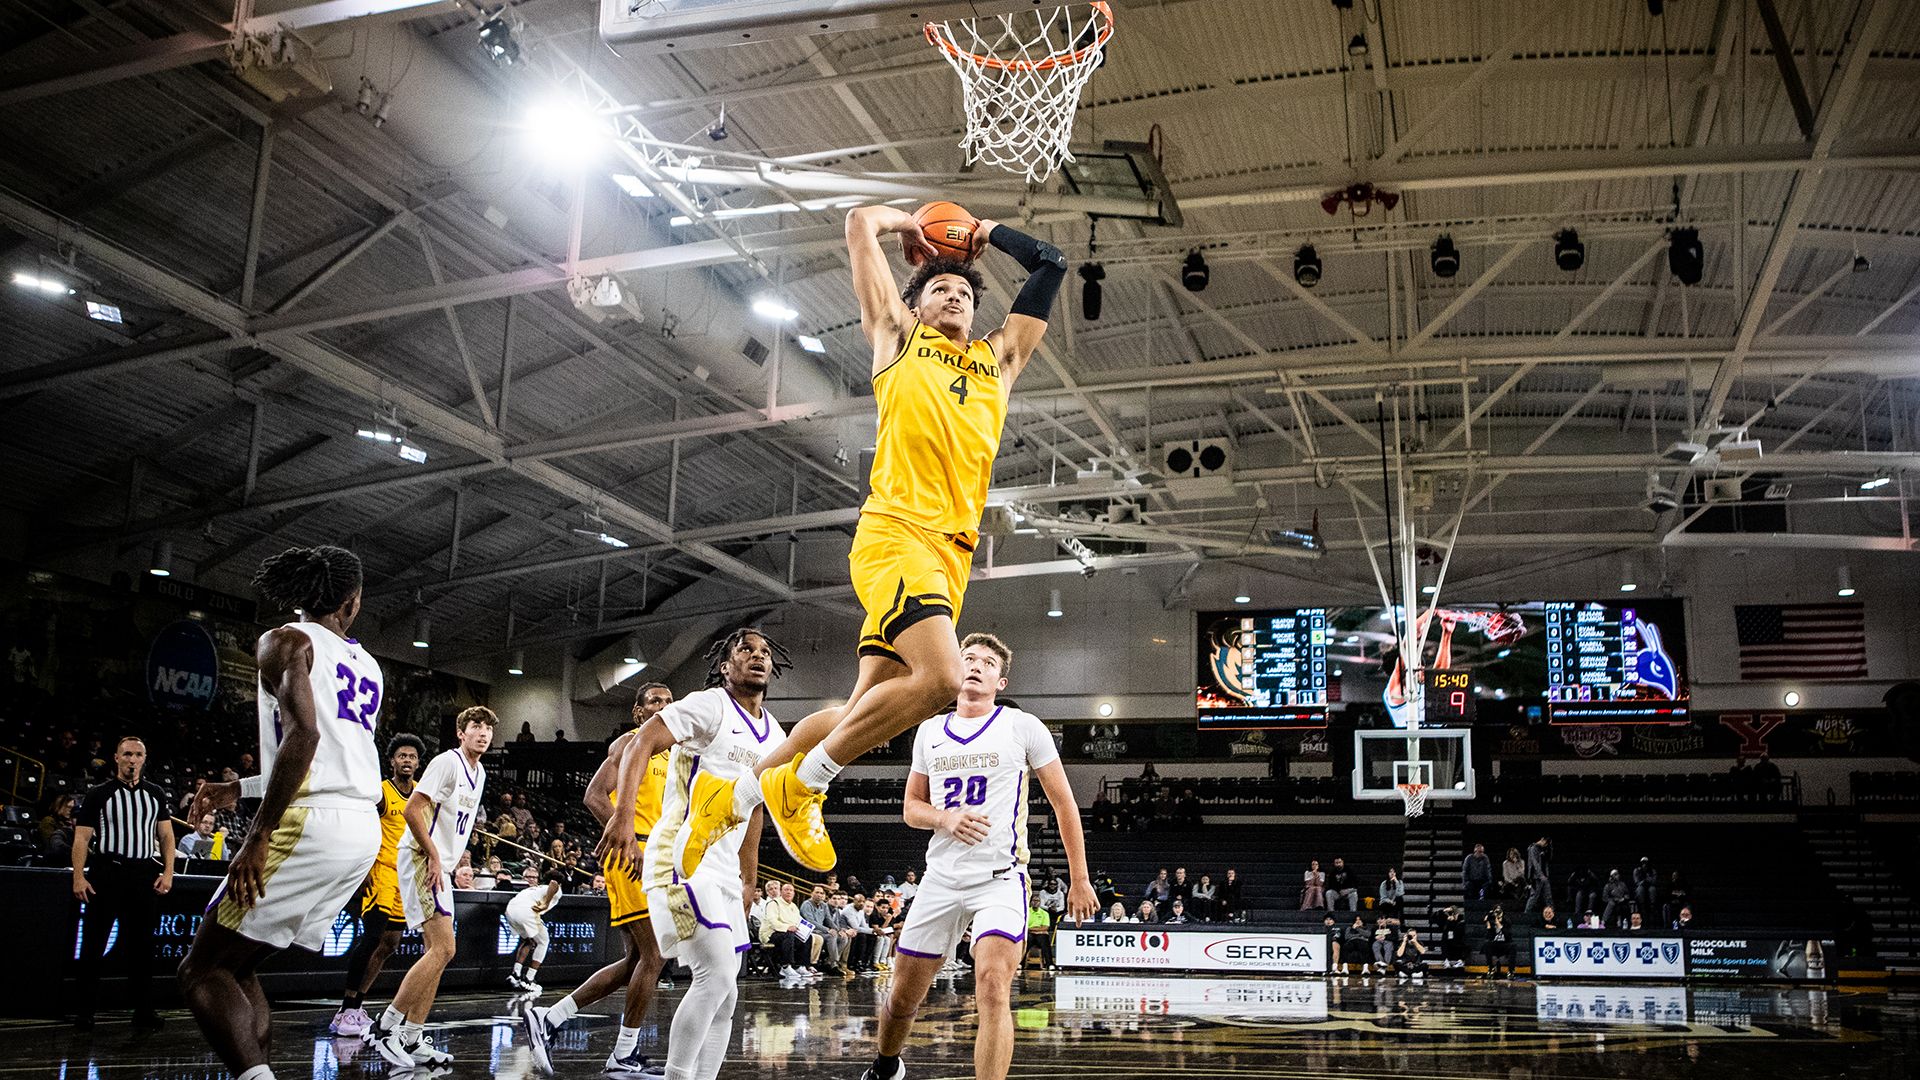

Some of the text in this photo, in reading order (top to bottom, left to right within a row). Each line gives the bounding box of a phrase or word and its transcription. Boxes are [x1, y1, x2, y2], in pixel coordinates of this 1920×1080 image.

[917, 347, 999, 379] OAKLAND
[949, 374, 968, 405] 4
[158, 581, 242, 613] GOLD ZONE
[1550, 611, 1633, 622] 0 1 3
[1314, 619, 1322, 627] 2
[1551, 626, 1636, 637] 0 0 20
[1315, 648, 1322, 656] 4
[1551, 641, 1637, 652] 0 0 22
[1315, 663, 1322, 671] 0
[1552, 658, 1559, 667] 0
[1567, 658, 1573, 667] 0
[154, 666, 213, 699] NCAA
[1315, 678, 1322, 686] 0
[1434, 673, 1469, 688] 15:40
[1553, 673, 1560, 682] 0
[1568, 673, 1574, 682] 0
[336, 662, 379, 735] 22
[1302, 692, 1314, 704] 11
[1450, 691, 1465, 715] 9
[1718, 713, 1786, 757] Y
[1299, 743, 1329, 755] RMU
[727, 745, 763, 768] JACK
[933, 752, 999, 772] JACKETS
[943, 775, 988, 809] 20
[1075, 934, 1136, 948] BELFOR
[1690, 940, 1747, 948] CHOCOLATE
[1226, 945, 1313, 960] SERRA
[1690, 948, 1715, 956] MILK
[1722, 958, 1746, 966] Sports
